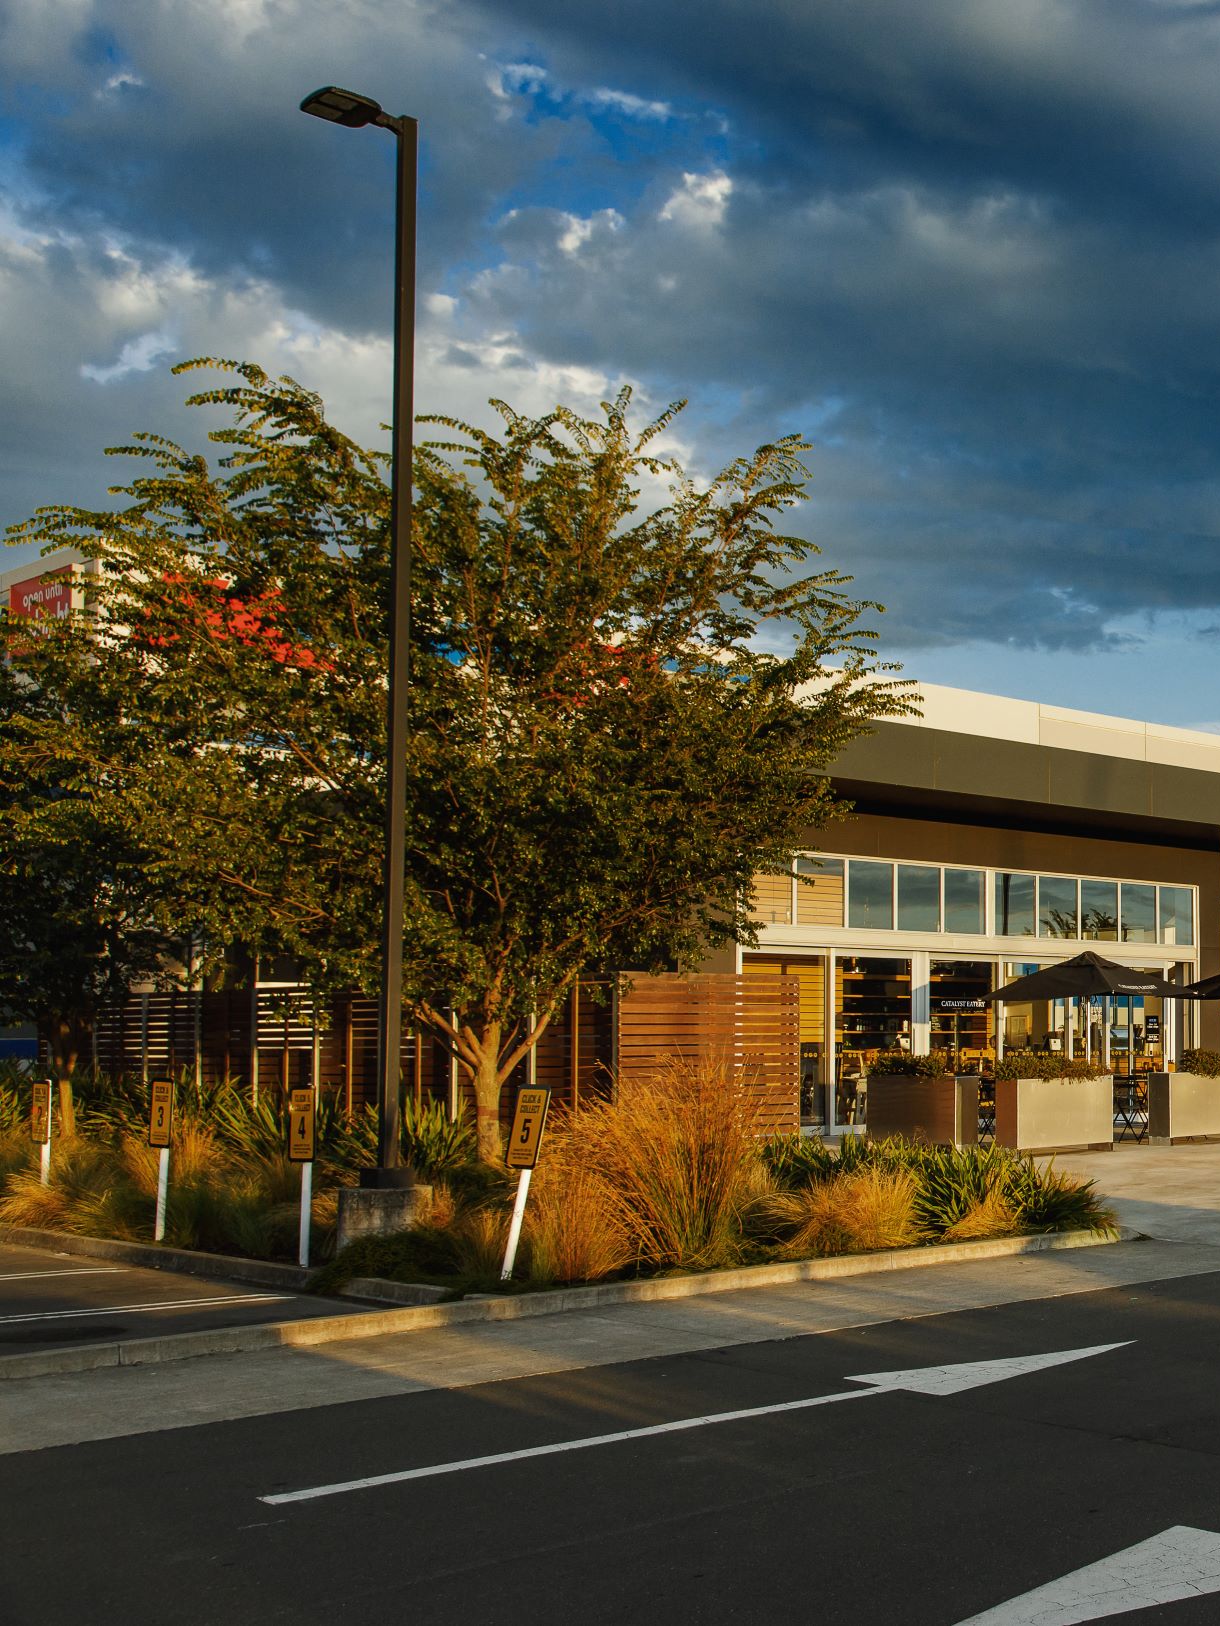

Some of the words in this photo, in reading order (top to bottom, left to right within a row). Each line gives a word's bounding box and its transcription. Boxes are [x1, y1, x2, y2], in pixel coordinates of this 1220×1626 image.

[22, 590, 44, 612] open
[966, 1000, 986, 1008] EATERY
[157, 1105, 165, 1128] 3
[297, 1115, 306, 1140] 4
[520, 1118, 533, 1144] 5
